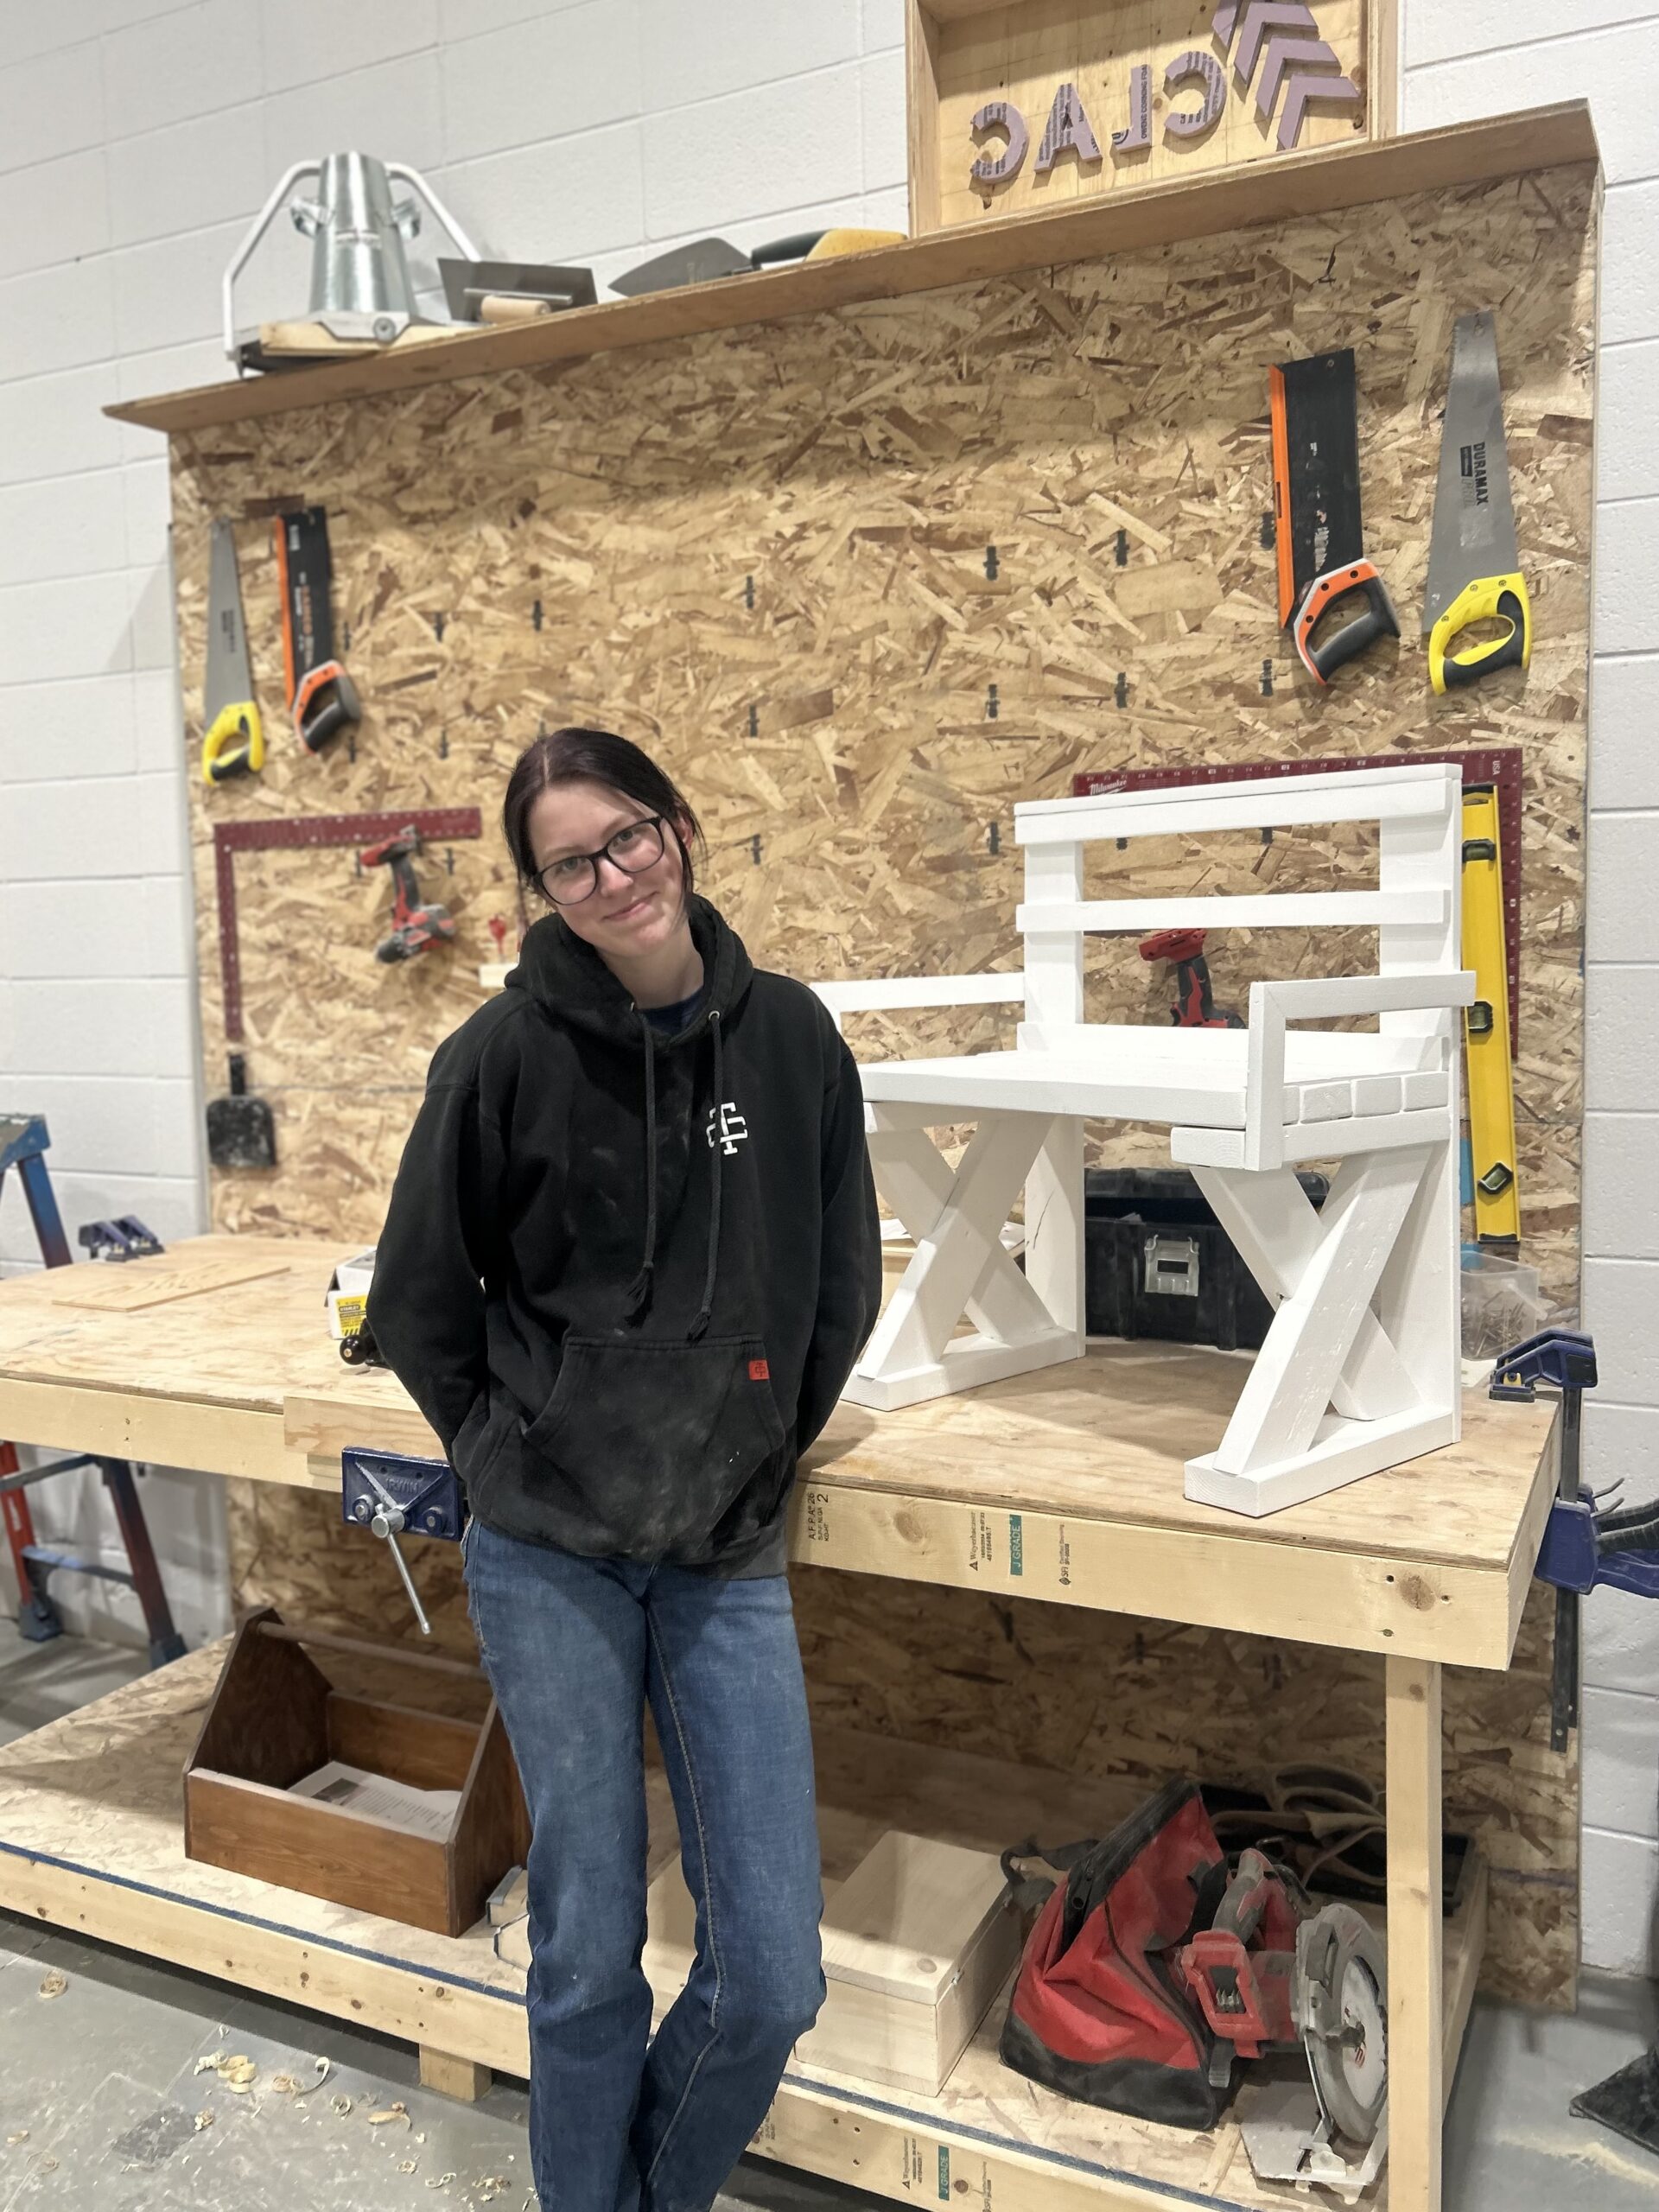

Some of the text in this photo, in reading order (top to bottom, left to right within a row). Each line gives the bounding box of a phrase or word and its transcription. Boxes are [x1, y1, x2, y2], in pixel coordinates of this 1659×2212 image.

[1473, 442, 1489, 505] DURAMAX
[1088, 779, 1128, 796] Milwaukee
[386, 1478, 419, 1495] IRWIN
[817, 1493, 829, 1503] 2
[1013, 1524, 1021, 1559] GRADE
[940, 2156, 949, 2186] GRADE
